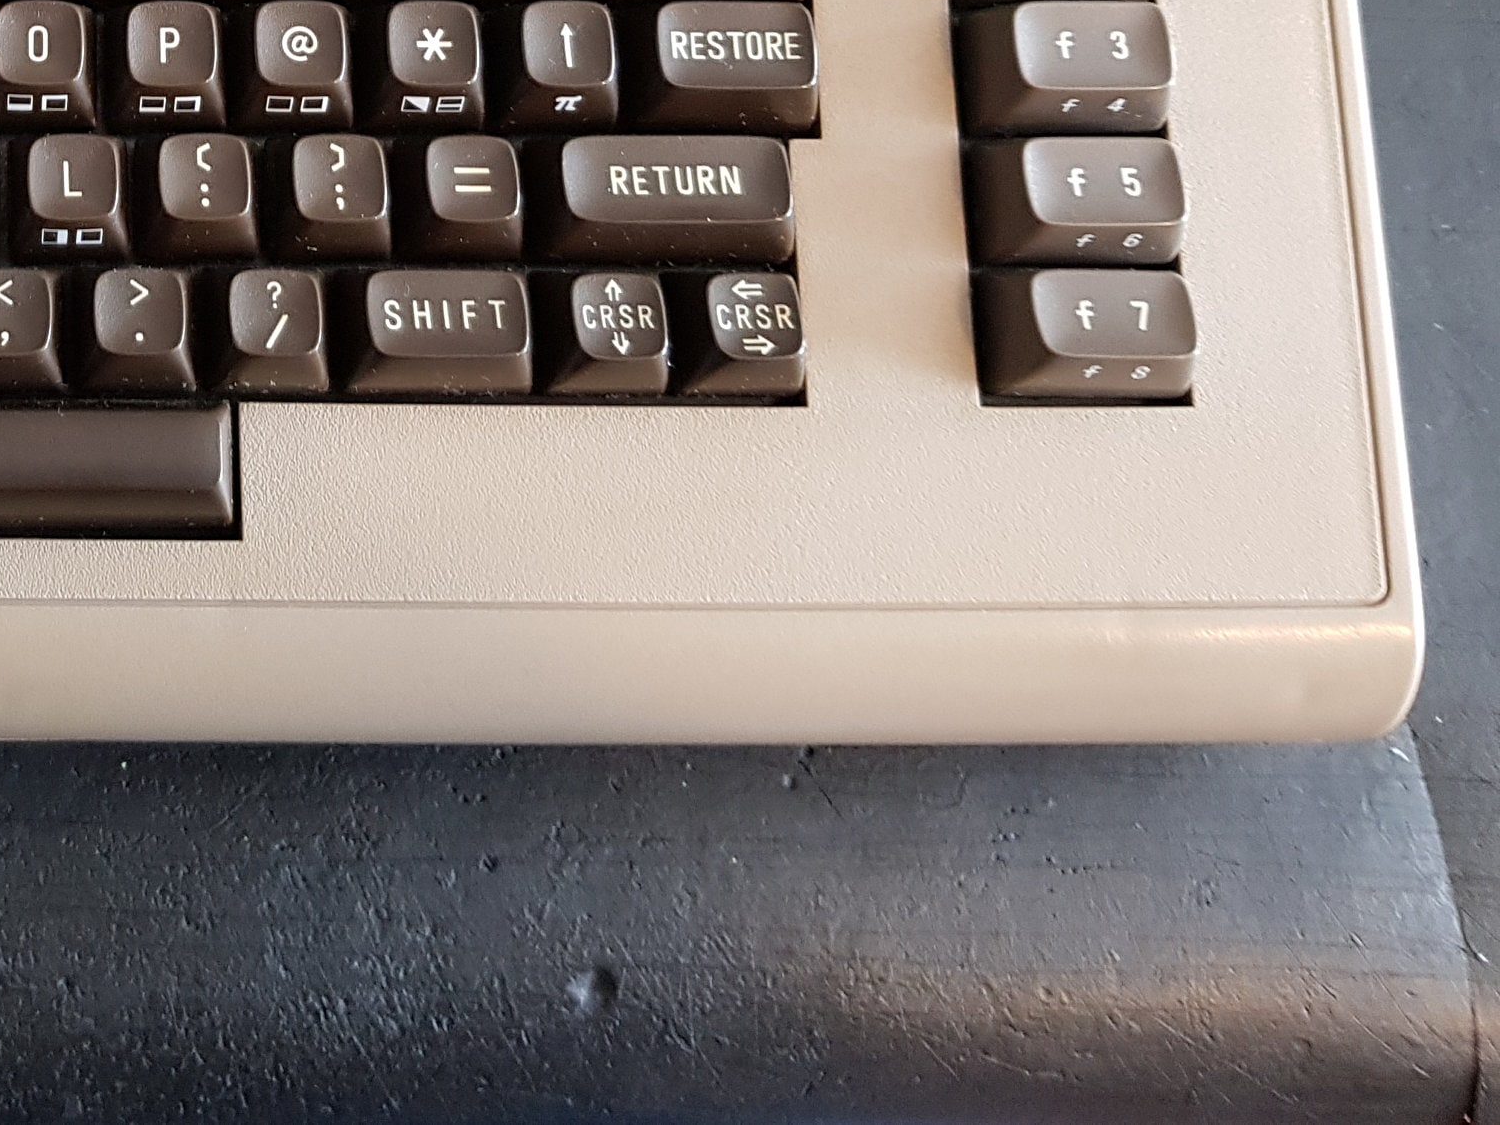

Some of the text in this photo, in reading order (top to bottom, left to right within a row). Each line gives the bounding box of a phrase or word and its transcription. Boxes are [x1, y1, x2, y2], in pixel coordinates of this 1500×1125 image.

[28, 25, 49, 63] O
[159, 27, 181, 64] P
[281, 25, 318, 62] @
[670, 30, 801, 61] RESTORE
[1055, 30, 1130, 60] f 3
[1061, 98, 1126, 113] f 4
[62, 160, 83, 198] L
[453, 166, 492, 193] =
[610, 165, 743, 195] RETURN
[1066, 167, 1142, 197] f 5
[1122, 233, 1143, 248] 6
[129, 279, 149, 306] >
[266, 281, 282, 309] ?
[383, 299, 506, 331] SHIFT
[582, 304, 655, 330] CRSR
[716, 304, 795, 330] CRSR
[1075, 299, 1149, 331] f 7
[266, 314, 289, 349] /
[1130, 365, 1151, 380] 8
